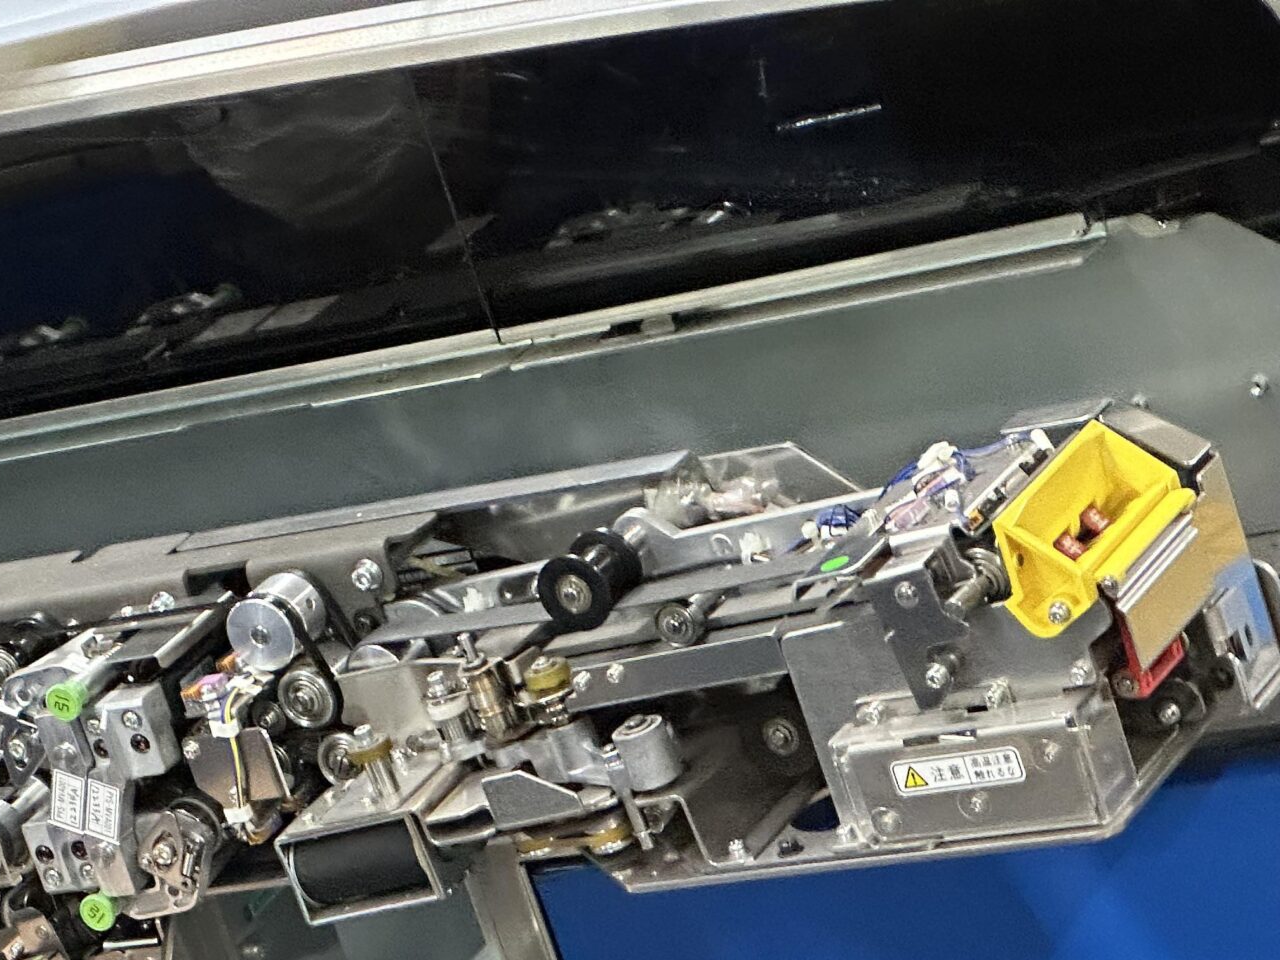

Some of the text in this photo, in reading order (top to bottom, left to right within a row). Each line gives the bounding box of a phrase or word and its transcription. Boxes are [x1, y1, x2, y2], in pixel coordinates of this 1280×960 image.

[930, 763, 964, 783] 注意
[973, 766, 1016, 781] 触れるな
